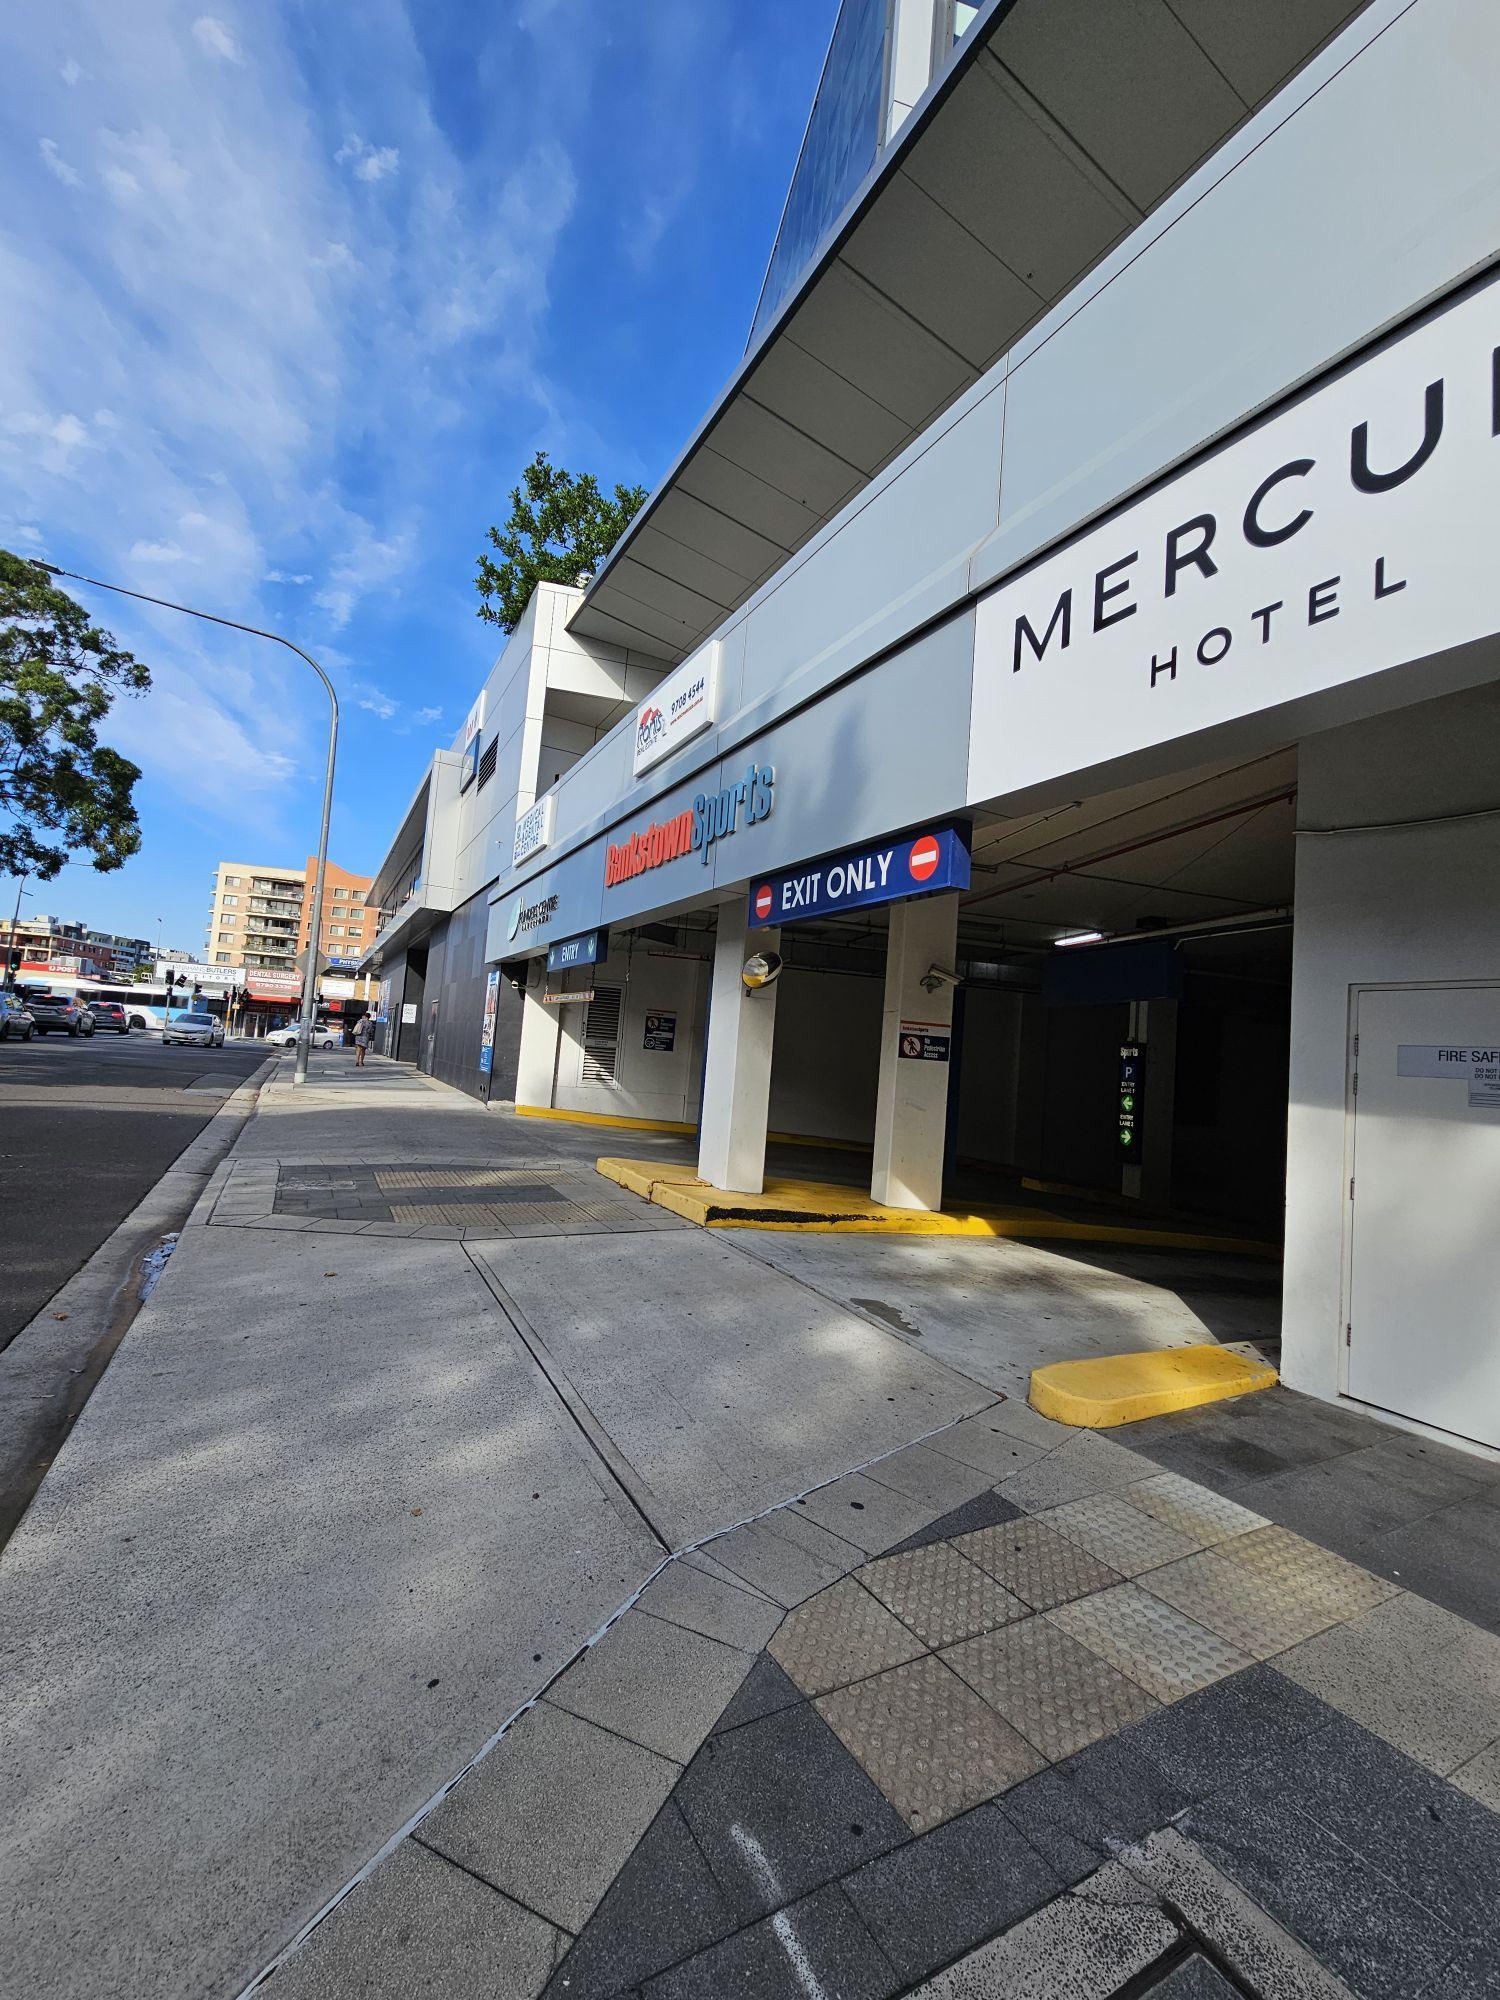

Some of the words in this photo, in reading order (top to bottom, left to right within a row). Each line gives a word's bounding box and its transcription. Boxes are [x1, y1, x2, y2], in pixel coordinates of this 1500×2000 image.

[1013, 343, 1500, 674] MERCU
[1150, 556, 1407, 688] HOTEL
[782, 872, 821, 910] EXIT
[826, 850, 894, 899] ONLY
[561, 943, 580, 963] ENTRY
[249, 970, 272, 978] DENTAL
[272, 972, 300, 980] SURGERY
[1438, 1050, 1467, 1062] FIRE
[1471, 1051, 1500, 1063] SAF
